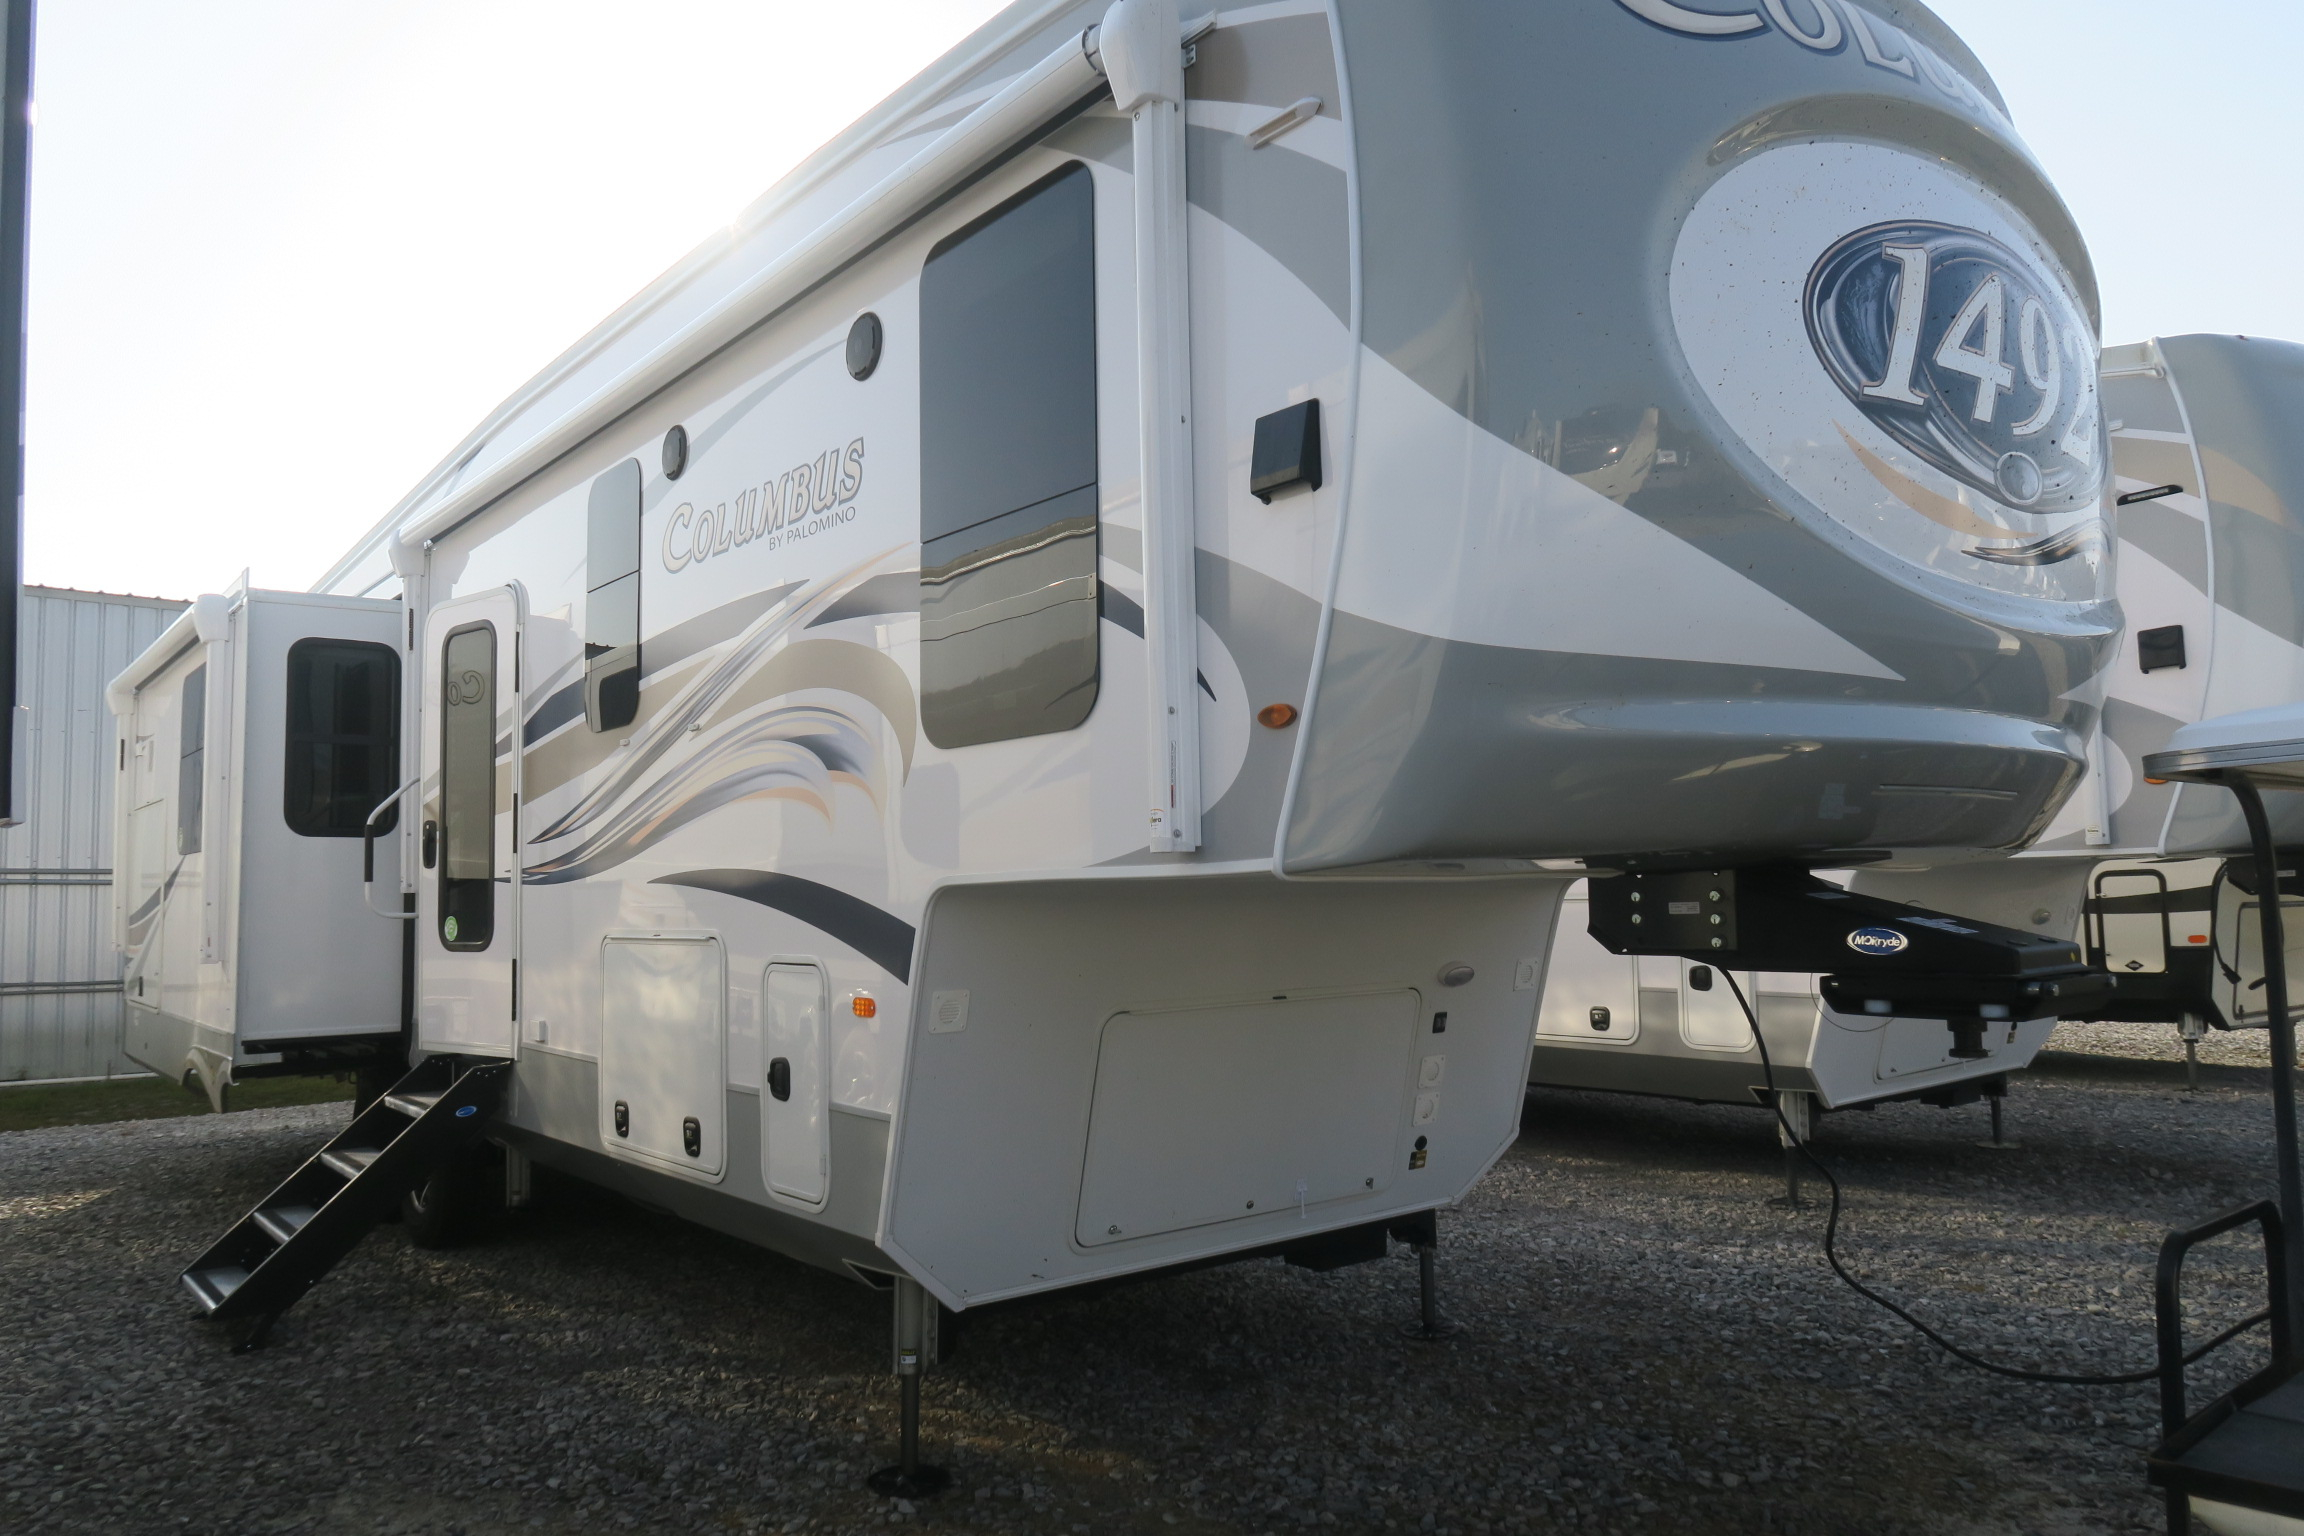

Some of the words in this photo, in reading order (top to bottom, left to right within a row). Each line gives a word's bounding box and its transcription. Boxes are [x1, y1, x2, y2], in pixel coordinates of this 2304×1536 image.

[1860, 242, 2098, 466] 1492
[662, 436, 864, 574] COLUMBUS
[769, 533, 784, 551] BY
[787, 506, 856, 544] PALOMINO
